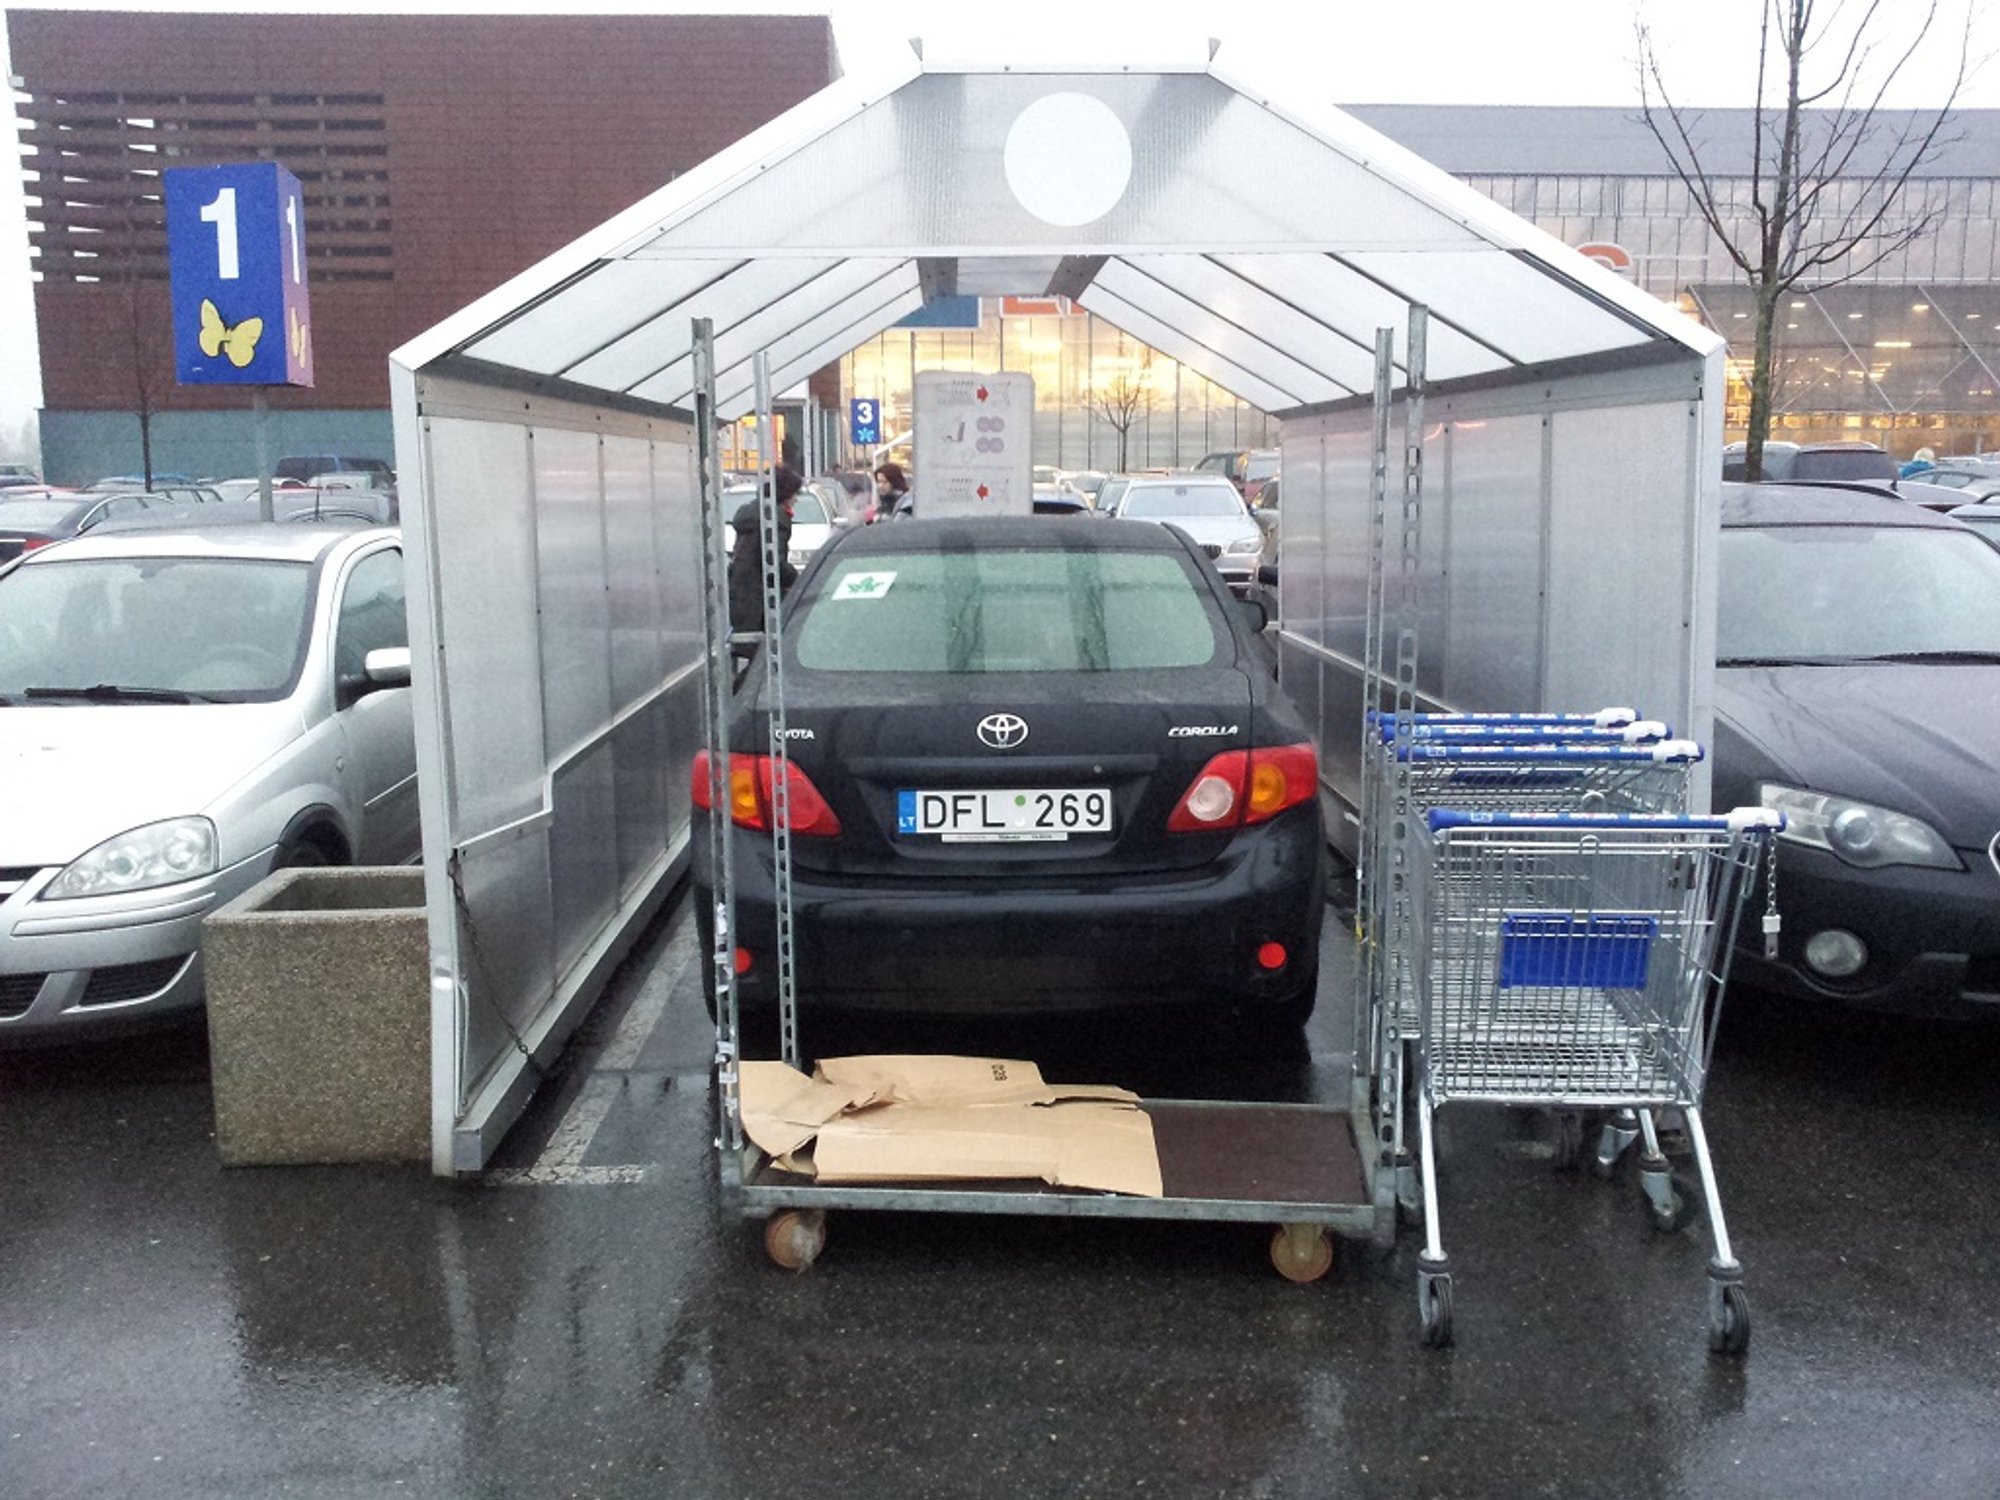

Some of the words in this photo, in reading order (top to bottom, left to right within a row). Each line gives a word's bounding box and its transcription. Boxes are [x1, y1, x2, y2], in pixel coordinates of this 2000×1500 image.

[201, 187, 240, 279] 1
[286, 195, 300, 285] 1
[857, 402, 873, 424] 3
[768, 728, 815, 739] OYOTA
[1168, 725, 1239, 737] COROLLA
[899, 816, 915, 827] LT
[923, 794, 1006, 828] DFL
[1035, 793, 1105, 828] 269
